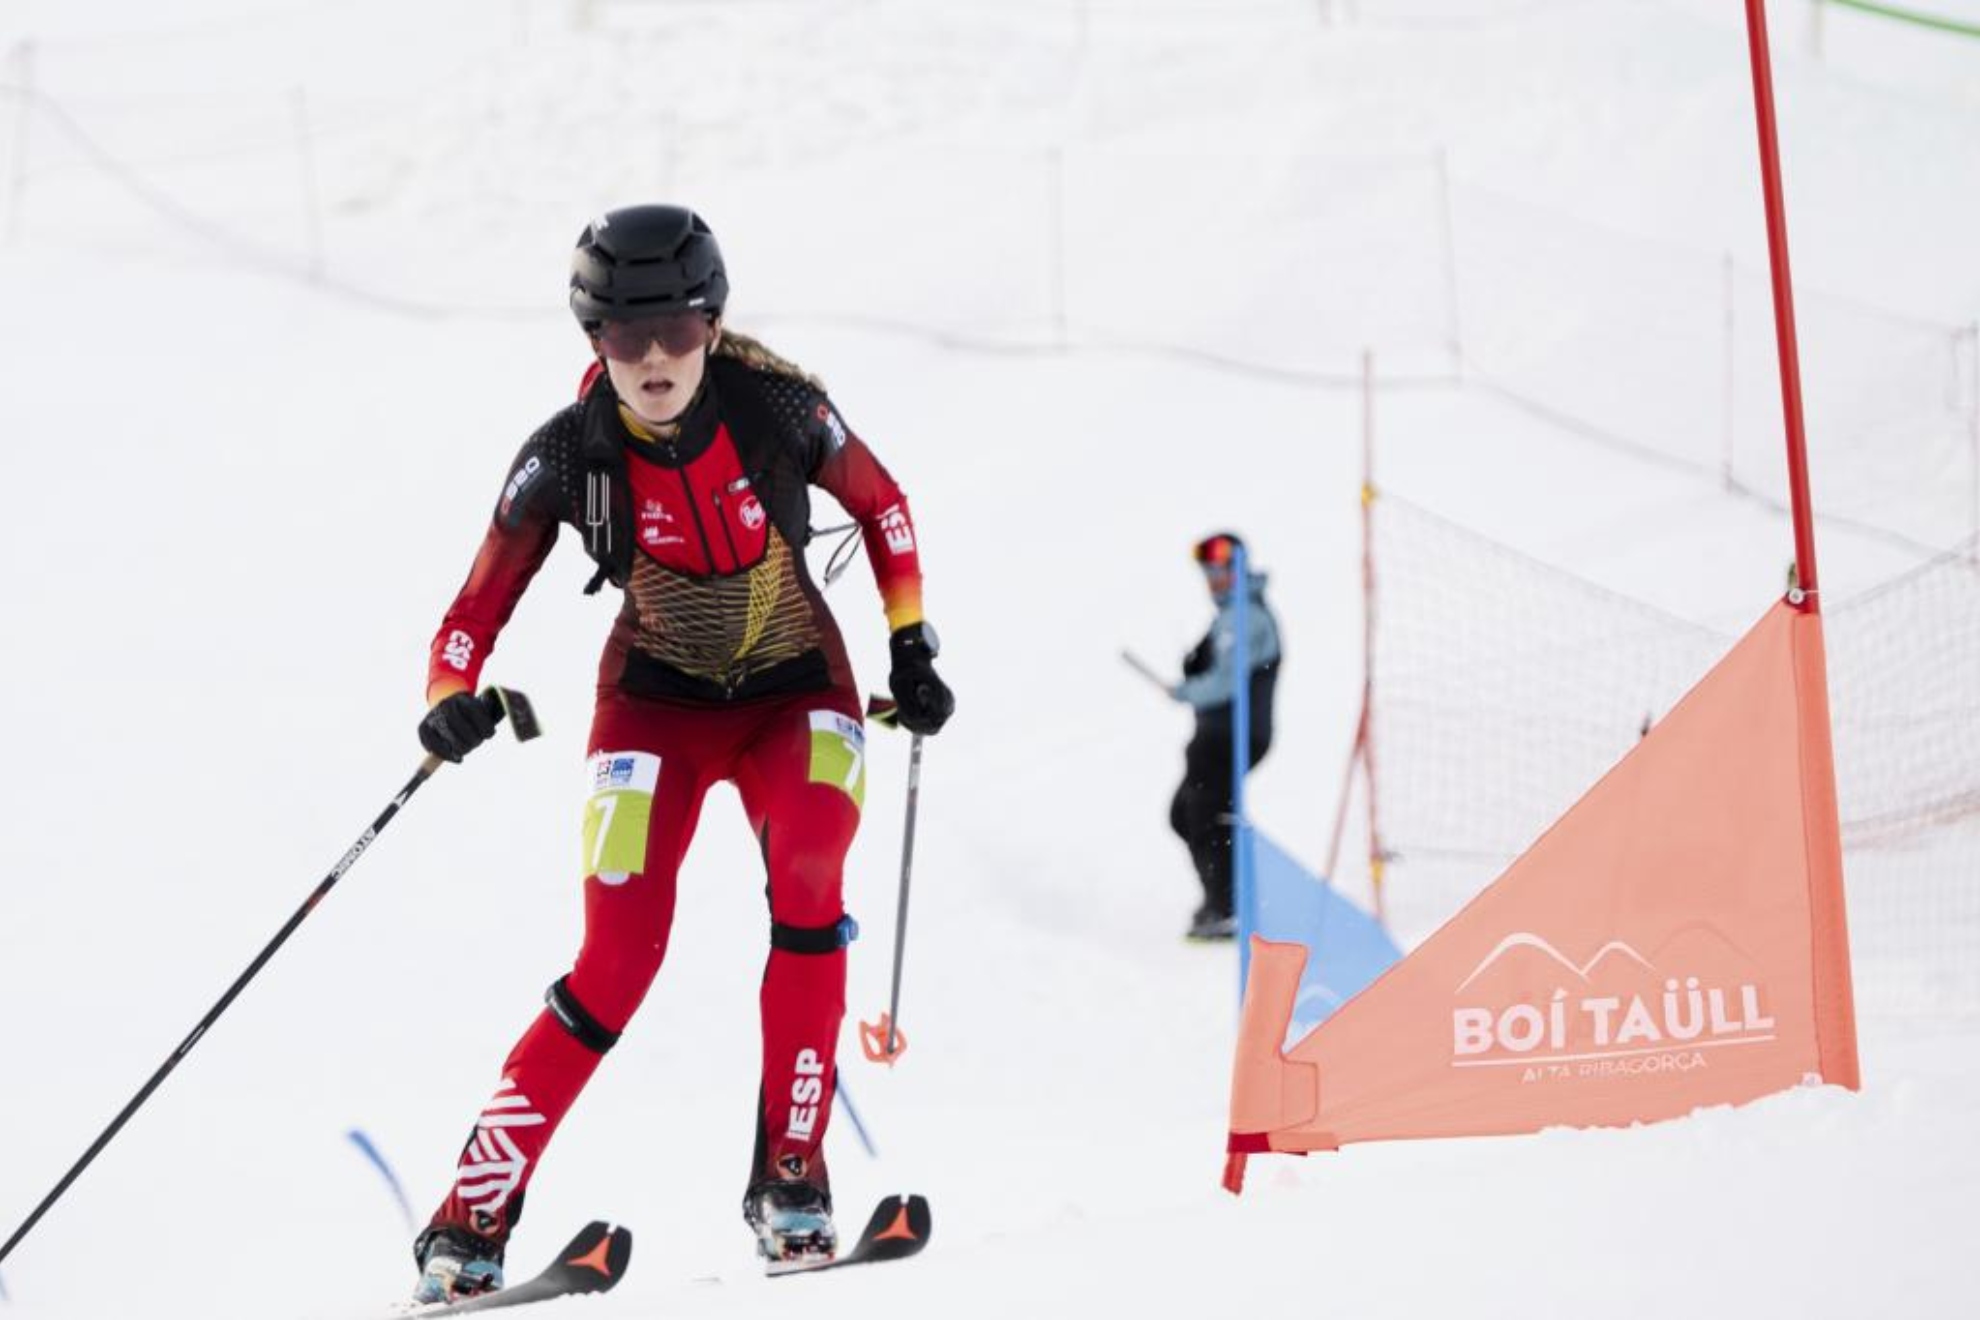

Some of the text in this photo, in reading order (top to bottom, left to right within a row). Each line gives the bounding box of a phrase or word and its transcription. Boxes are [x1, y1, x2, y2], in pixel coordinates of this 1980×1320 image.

[592, 793, 619, 868] 7
[1453, 976, 1776, 1055] BOÍ TAÜLL
[785, 1047, 824, 1142] ESP
